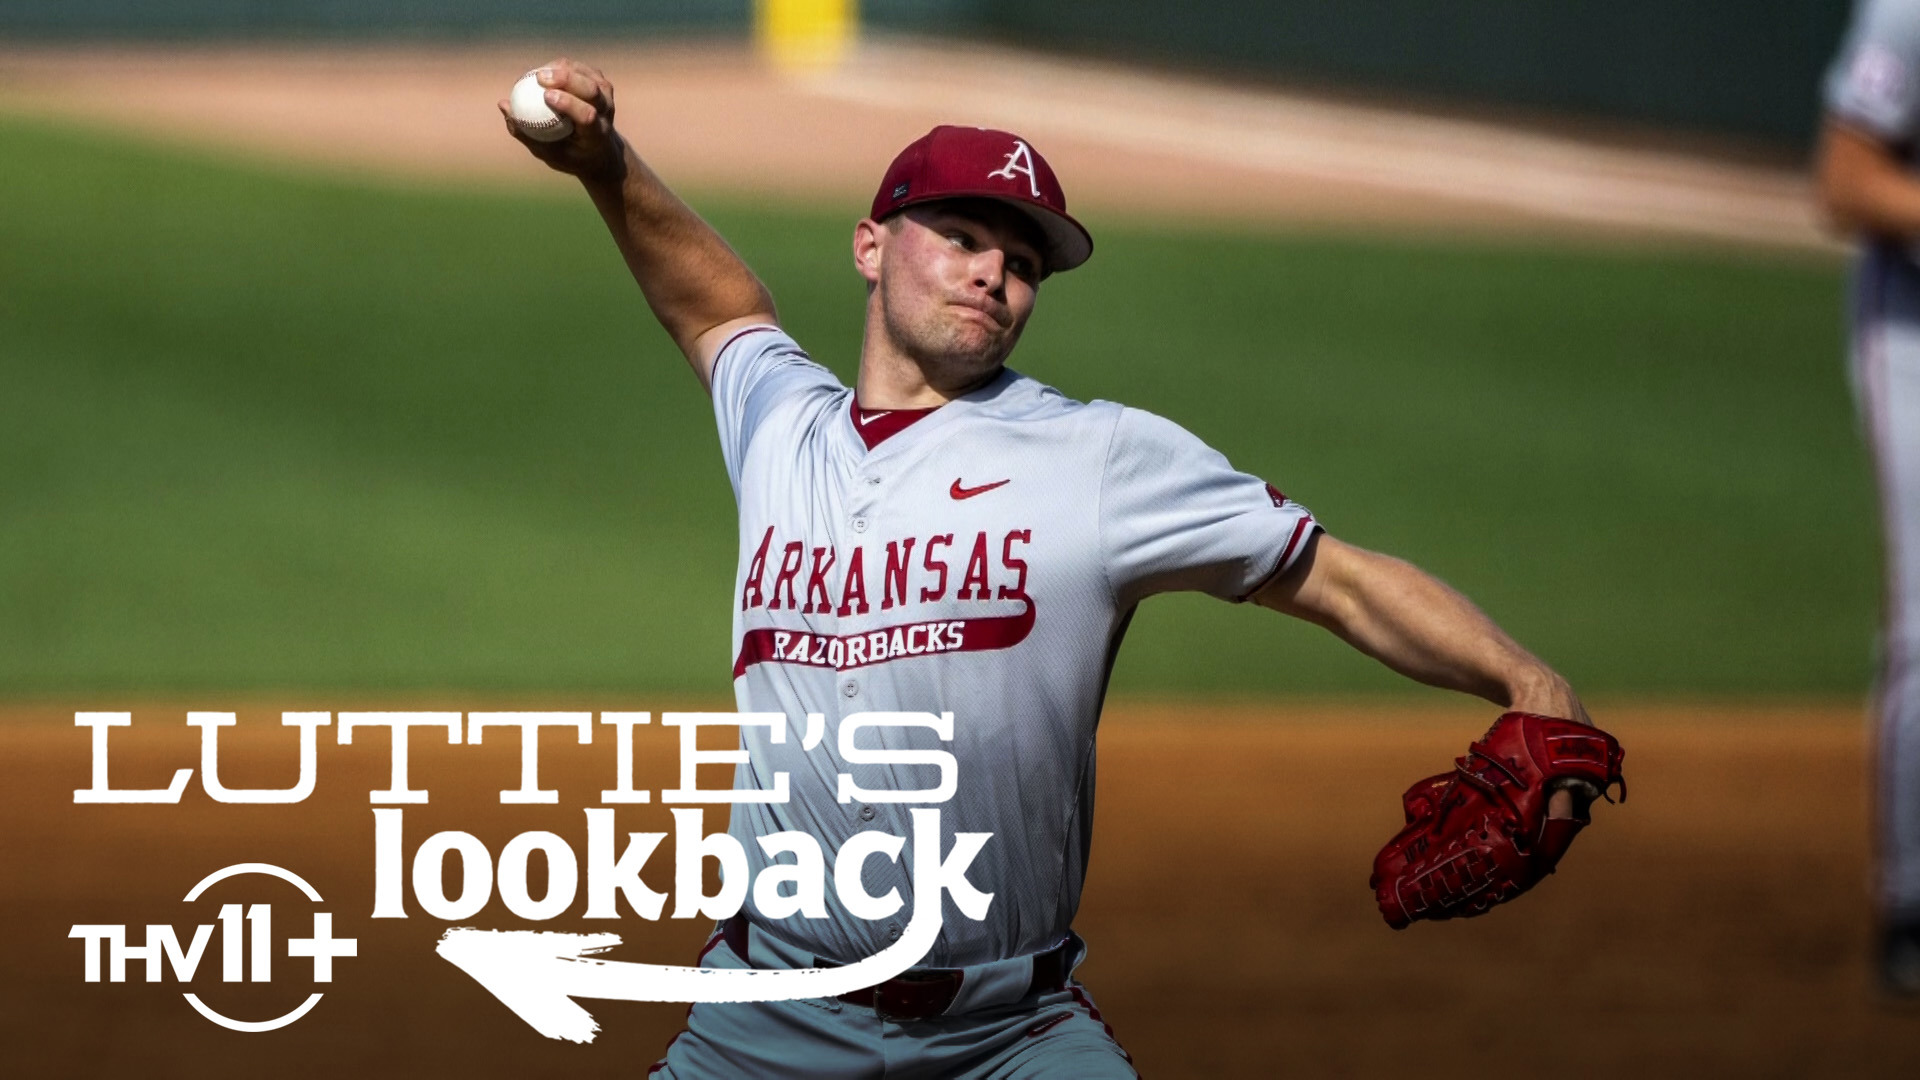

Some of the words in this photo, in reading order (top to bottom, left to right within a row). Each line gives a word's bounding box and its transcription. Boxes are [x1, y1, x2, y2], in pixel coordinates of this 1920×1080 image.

[988, 141, 1040, 197] A
[742, 526, 1031, 617] ARKANSAS
[772, 621, 965, 668] RAZORBACKS
